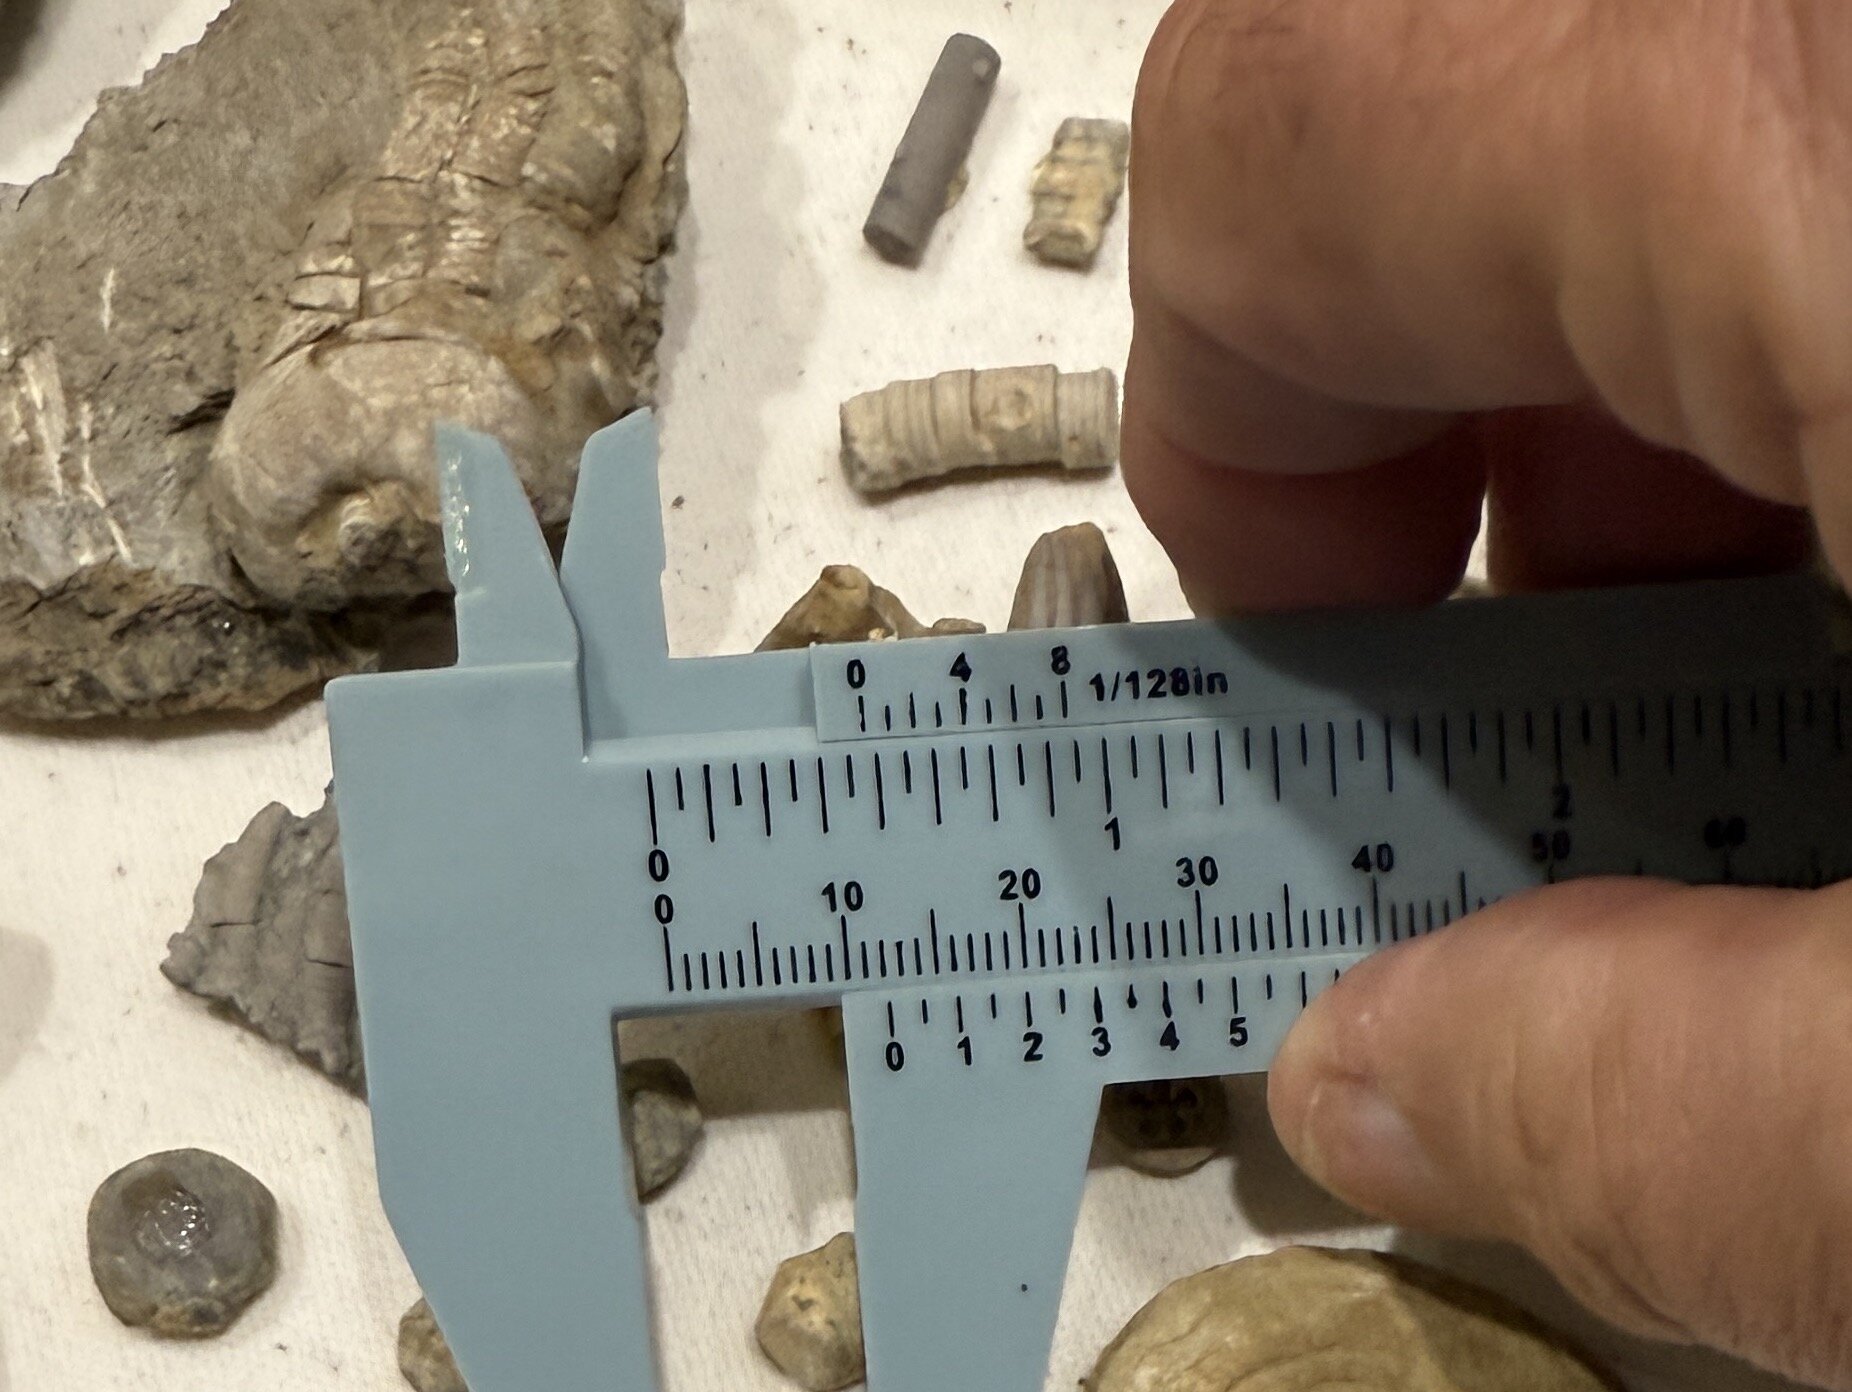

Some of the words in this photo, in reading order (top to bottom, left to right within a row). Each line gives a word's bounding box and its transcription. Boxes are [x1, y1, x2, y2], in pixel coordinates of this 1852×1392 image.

[846, 658, 866, 690] 0
[949, 651, 972, 683] 4
[1050, 645, 1071, 676] 8
[1089, 666, 1229, 702] 1/128in
[648, 848, 670, 883] 0
[1104, 817, 1121, 851] 1
[1553, 782, 1573, 820] 2
[654, 894, 674, 925] 0
[821, 880, 864, 913] 10
[998, 868, 1041, 901] 20
[1175, 855, 1219, 888] 30
[1351, 842, 1395, 873] 40
[1530, 829, 1571, 862] 50
[886, 1040, 905, 1072] 0
[957, 1035, 972, 1066] 1
[1022, 1031, 1044, 1063] 2
[1091, 1026, 1112, 1057] 3
[1159, 1020, 1180, 1051] 4
[1229, 1016, 1249, 1048] 5
